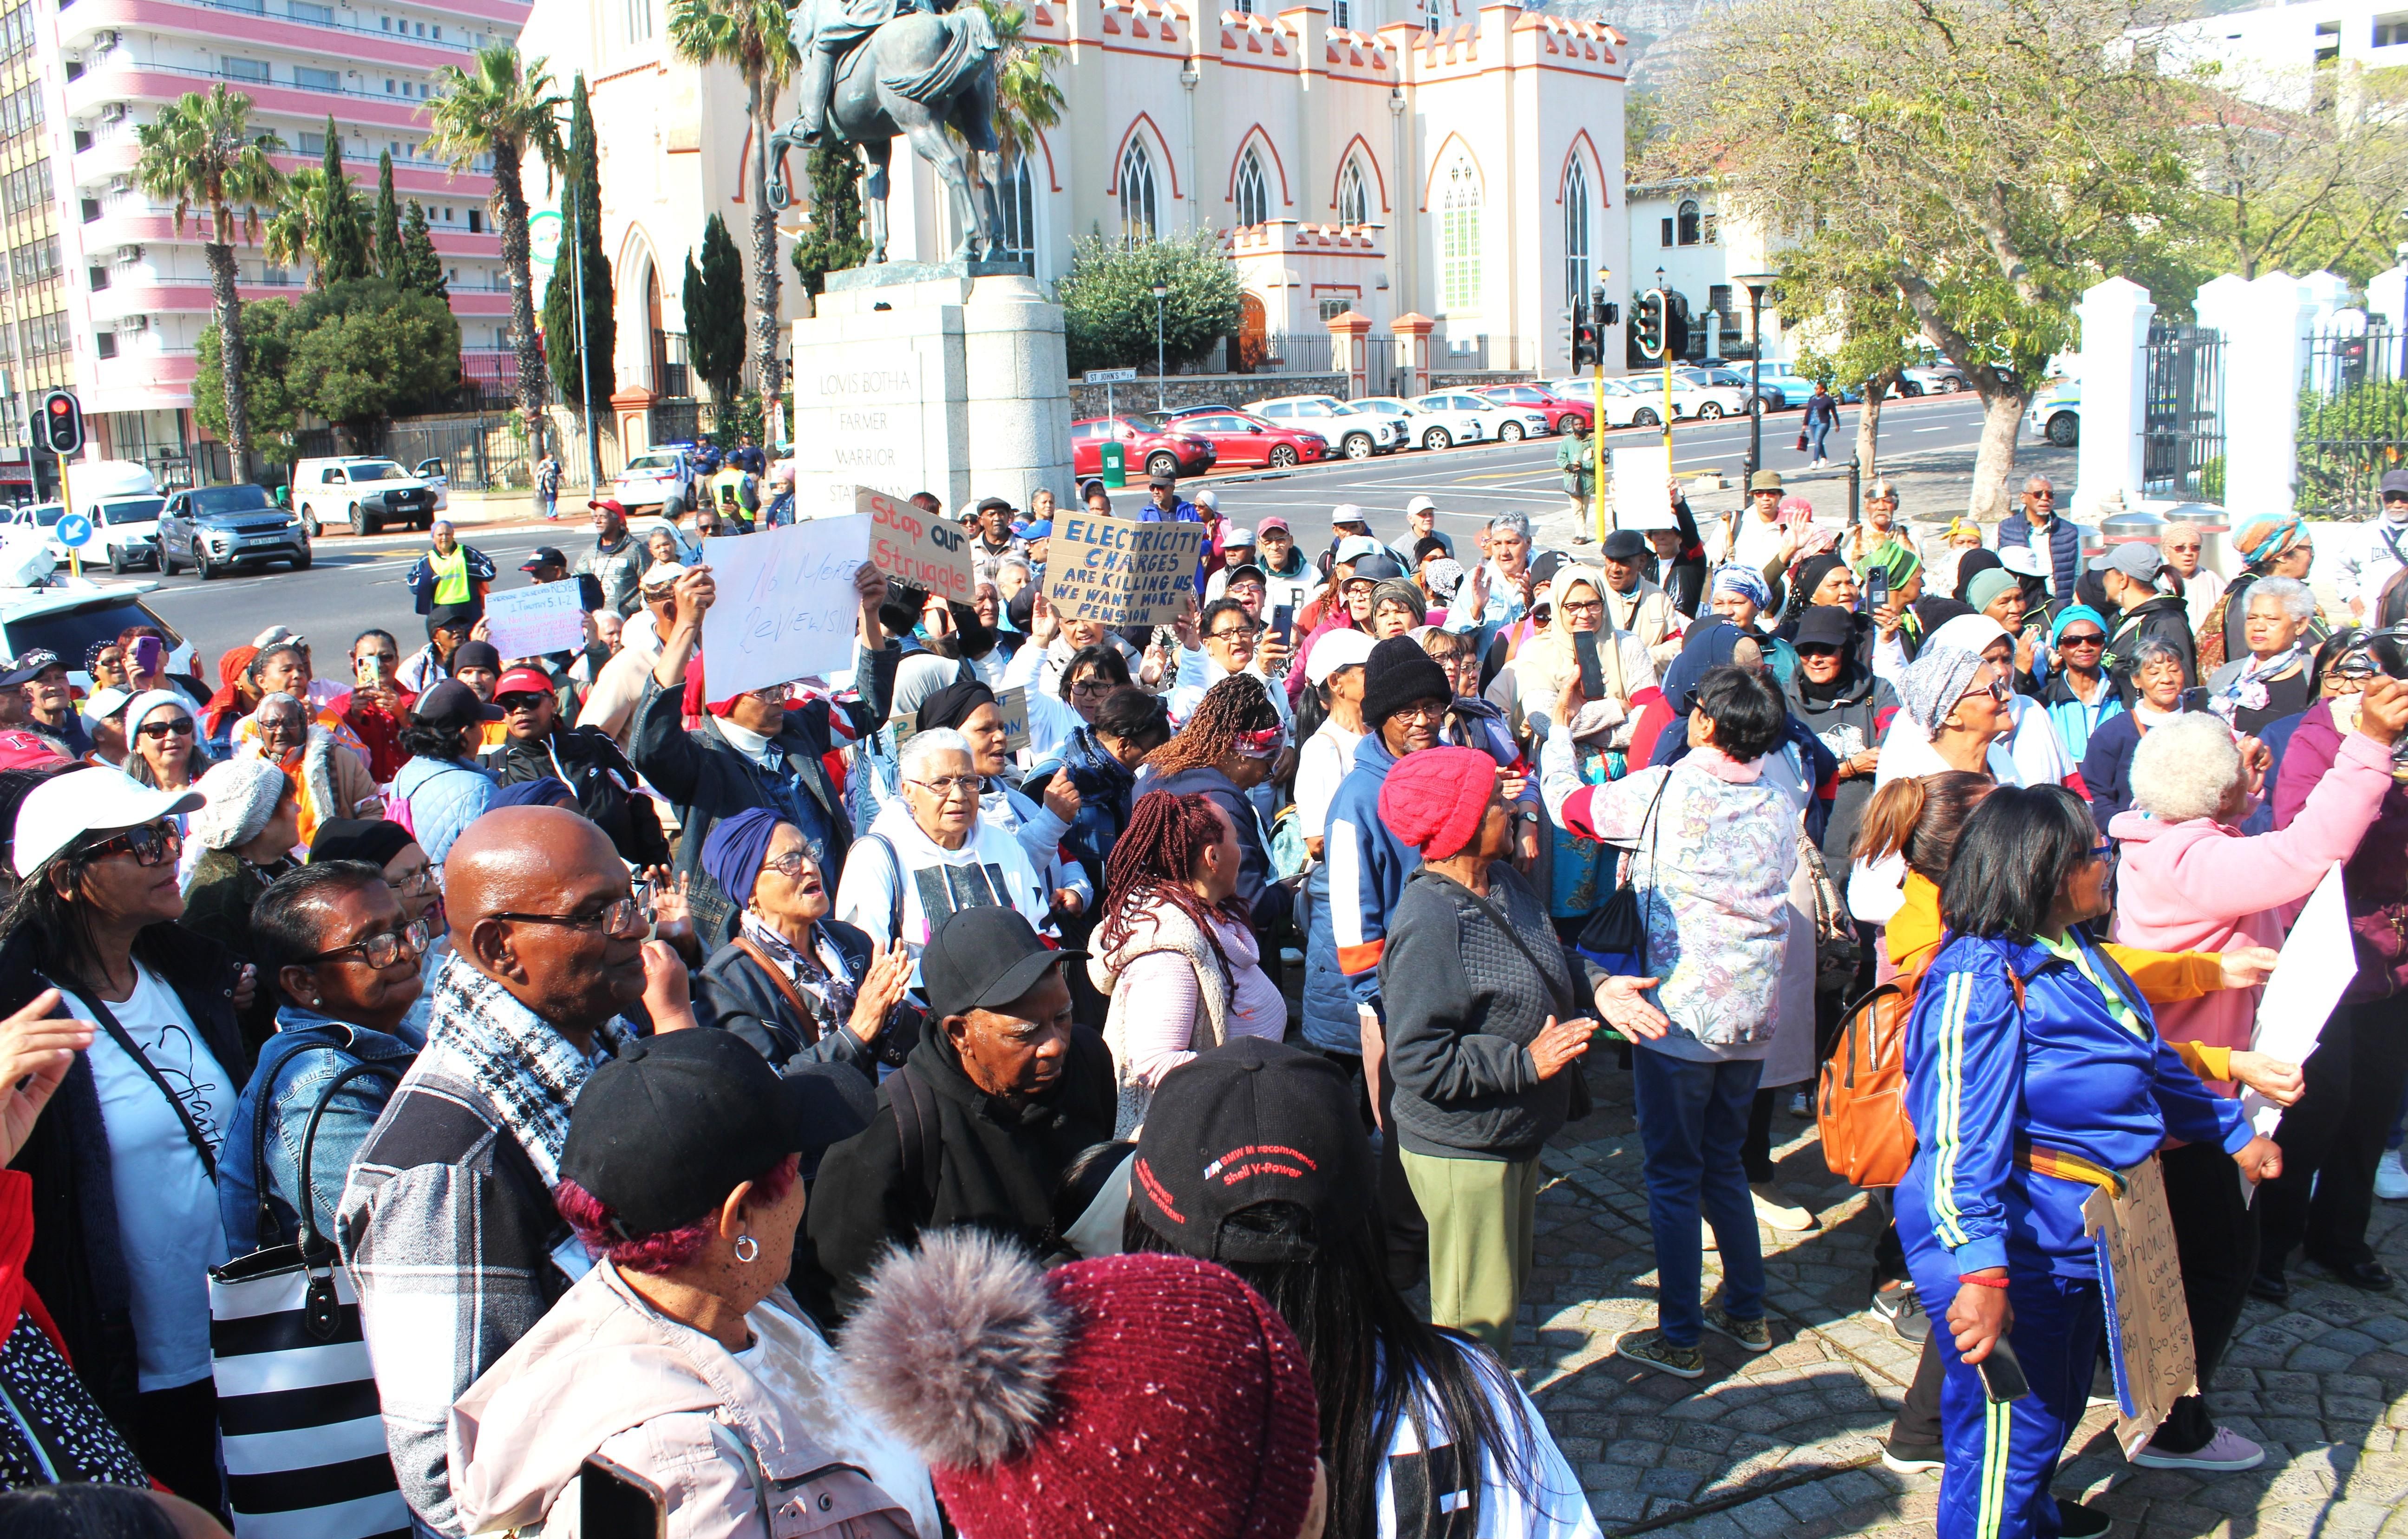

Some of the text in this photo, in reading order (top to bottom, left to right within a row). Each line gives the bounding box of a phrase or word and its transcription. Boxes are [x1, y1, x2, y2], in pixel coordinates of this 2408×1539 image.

[863, 371, 911, 392] BOTHA
[1100, 372, 1119, 381] JOHN'S
[840, 412, 887, 430] FARMER
[835, 449, 895, 465] WARRIOR
[871, 496, 923, 545] Stop
[1065, 520, 1201, 553] ELECTRICITY
[874, 539, 967, 600] Struggle
[1084, 548, 1179, 573] CHARGES
[550, 580, 578, 593] RESPECT
[1063, 568, 1192, 592] ARE KILLING US
[1053, 583, 1176, 606] WE WANT MORE
[1076, 603, 1150, 623] PENSION
[1220, 1145, 1317, 1170] BMW M recommends
[1223, 1162, 1302, 1185] Shell V-Power
